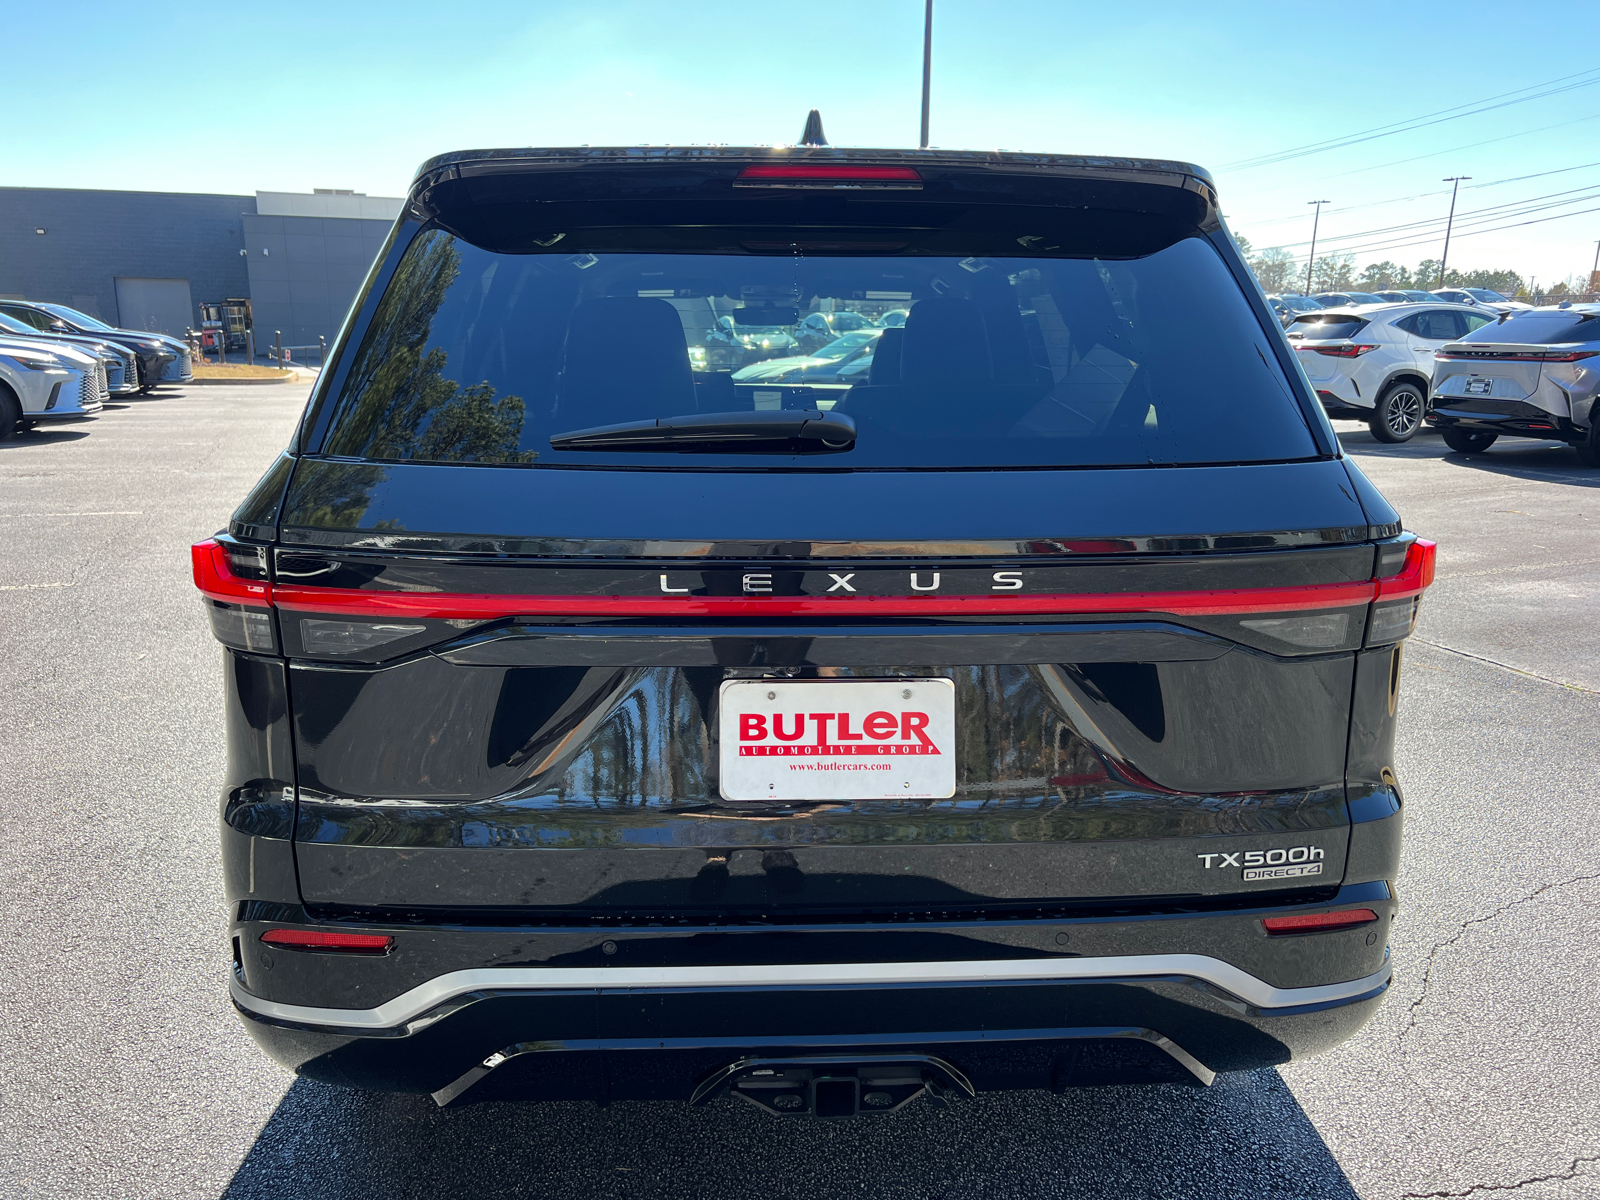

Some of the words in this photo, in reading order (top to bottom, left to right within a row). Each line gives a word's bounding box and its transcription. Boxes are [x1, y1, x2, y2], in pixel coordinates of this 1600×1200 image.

[659, 571, 1024, 593] LEXUS
[740, 746, 857, 755] AUTOMOTIVE
[877, 745, 935, 755] GROUP
[789, 762, 892, 771] www.butlercars.com
[1197, 846, 1325, 869] TX500h
[1245, 864, 1321, 880] DIRECT4
